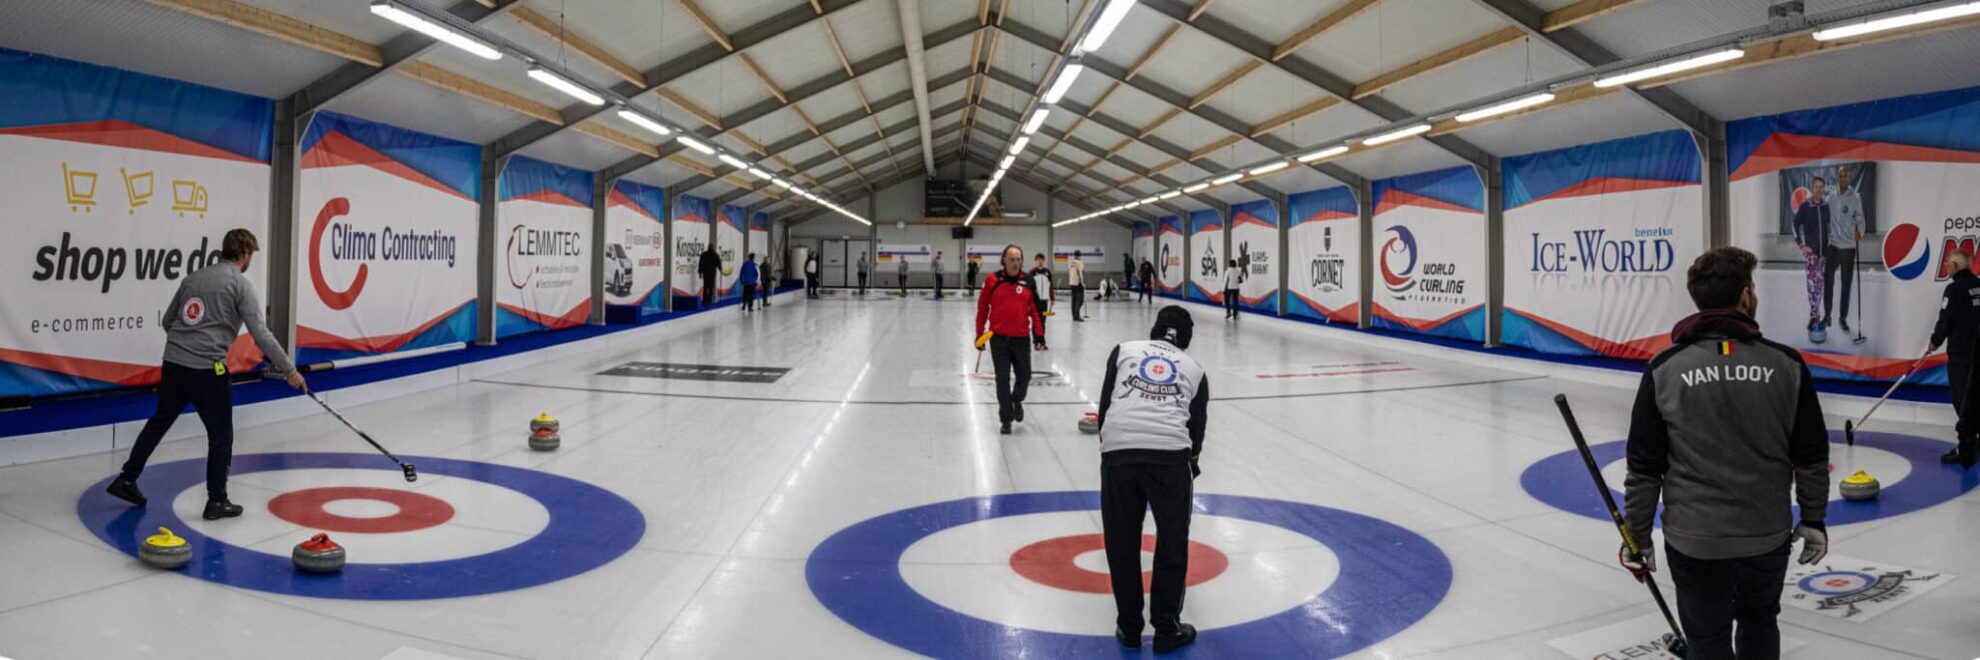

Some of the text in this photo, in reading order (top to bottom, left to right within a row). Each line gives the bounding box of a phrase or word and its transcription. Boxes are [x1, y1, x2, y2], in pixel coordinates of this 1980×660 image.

[331, 223, 456, 268] Clima Contracting
[518, 229, 581, 256] LEMMTEC
[1531, 229, 1674, 272] ICE-WORLD
[32, 232, 127, 293] shop
[135, 248, 183, 280] we
[1201, 256, 1218, 277] SPA
[1311, 259, 1344, 289] CORNET
[1423, 263, 1455, 275] WORLD
[1420, 278, 1465, 294] CURLING
[31, 314, 144, 333] e-commerce
[1681, 364, 1774, 387] VAN LOOY
